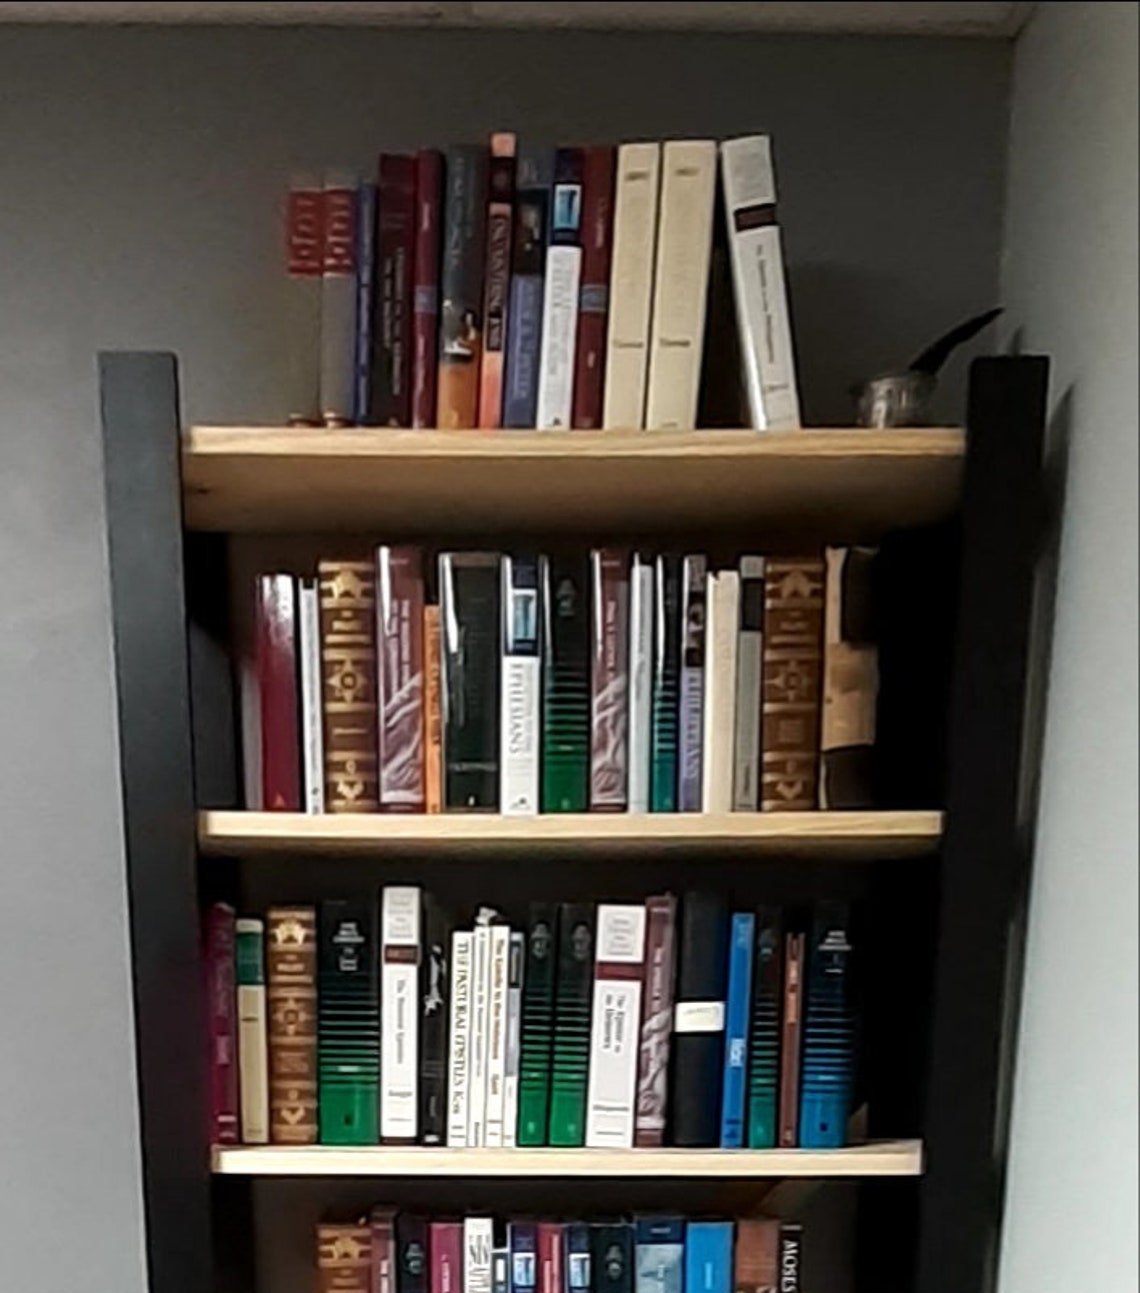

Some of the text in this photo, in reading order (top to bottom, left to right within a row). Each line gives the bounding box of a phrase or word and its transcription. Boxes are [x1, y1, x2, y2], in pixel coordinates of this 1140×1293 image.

[508, 662, 525, 755] EPHESIANS
[456, 940, 470, 966] THE
[454, 969, 470, 1031] PASTORAL
[453, 1033, 467, 1087] EPISTLES
[781, 1239, 799, 1293] MOSES
